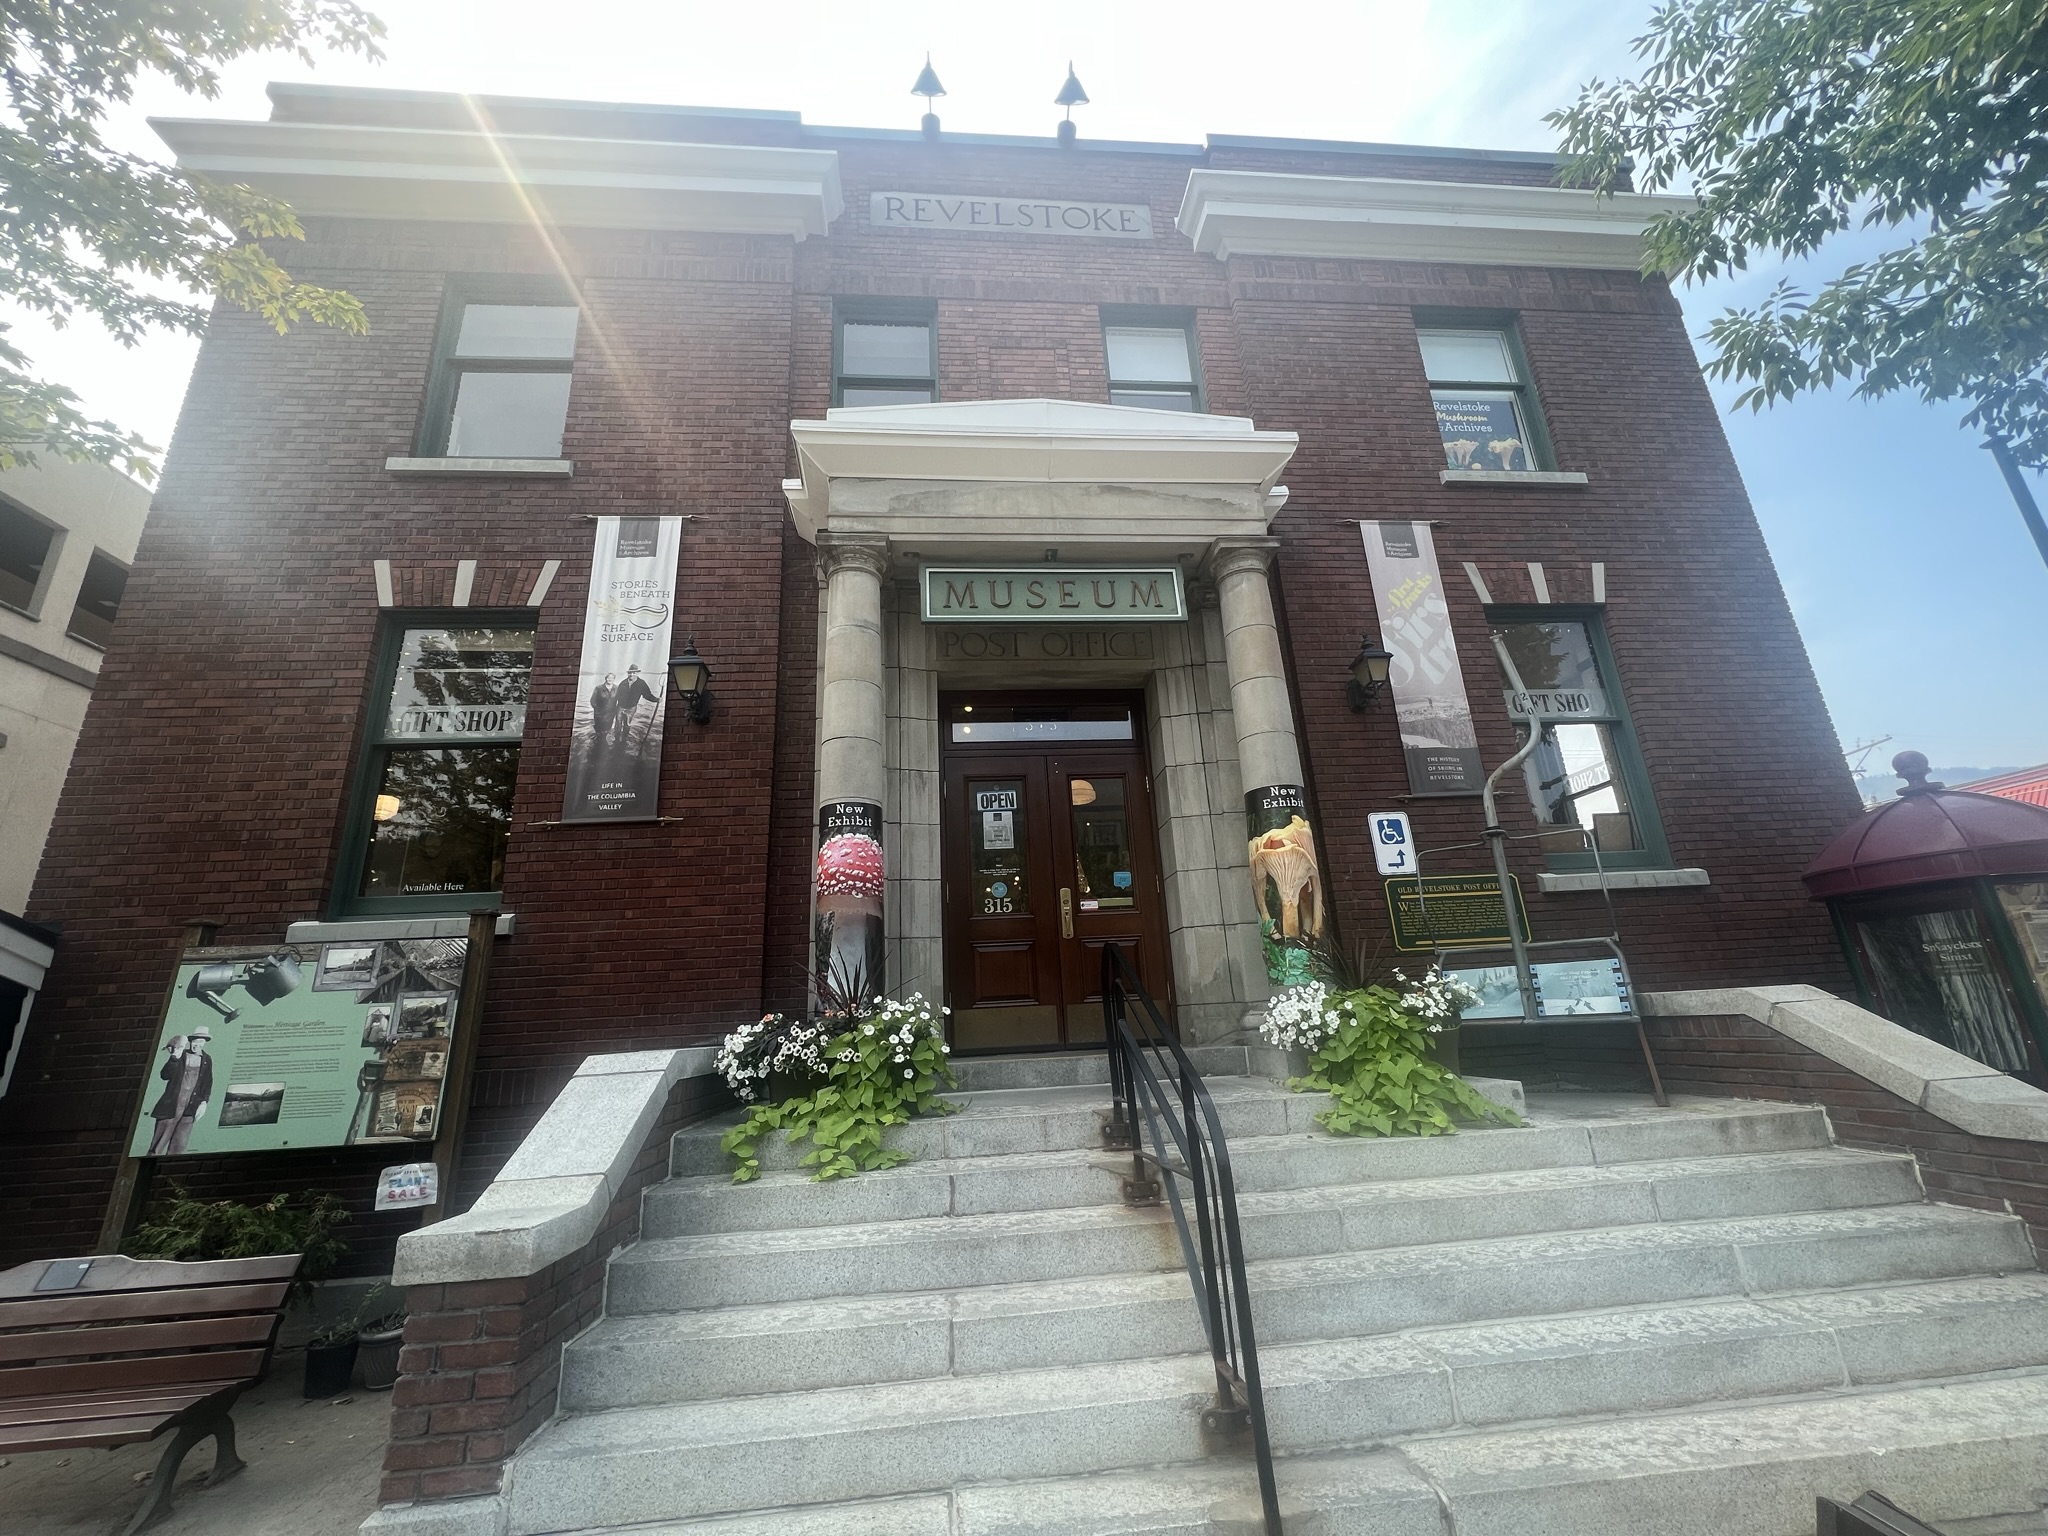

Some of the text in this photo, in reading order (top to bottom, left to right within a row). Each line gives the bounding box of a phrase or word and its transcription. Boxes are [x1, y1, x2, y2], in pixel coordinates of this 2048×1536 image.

[884, 196, 1141, 232] REVELSTOKE
[1433, 401, 1491, 412] Revelstoke
[1436, 411, 1489, 422] Mushroom
[1445, 422, 1493, 432] Archives
[610, 580, 659, 589] STORIES
[619, 590, 670, 599] BENEATH
[942, 580, 1164, 609] MUSEUM
[602, 623, 626, 633] THE
[600, 632, 654, 643] SURFACE
[943, 630, 1148, 658] POST OFFICE
[1511, 693, 1551, 713] GFT
[454, 710, 513, 732] SHOP
[600, 792, 636, 800] COLUMBIA
[1269, 786, 1297, 797] New
[980, 792, 1016, 809] OPEN
[1262, 797, 1304, 809] Exhibit
[598, 803, 622, 811] VALLEY
[835, 803, 864, 814] New
[827, 815, 873, 827] Exhibit
[402, 881, 465, 893] Available Here
[1397, 886, 1412, 894] OLD
[984, 897, 1013, 914] 315
[1939, 953, 1974, 962] Sinixt
[387, 1186, 428, 1200] SALE
